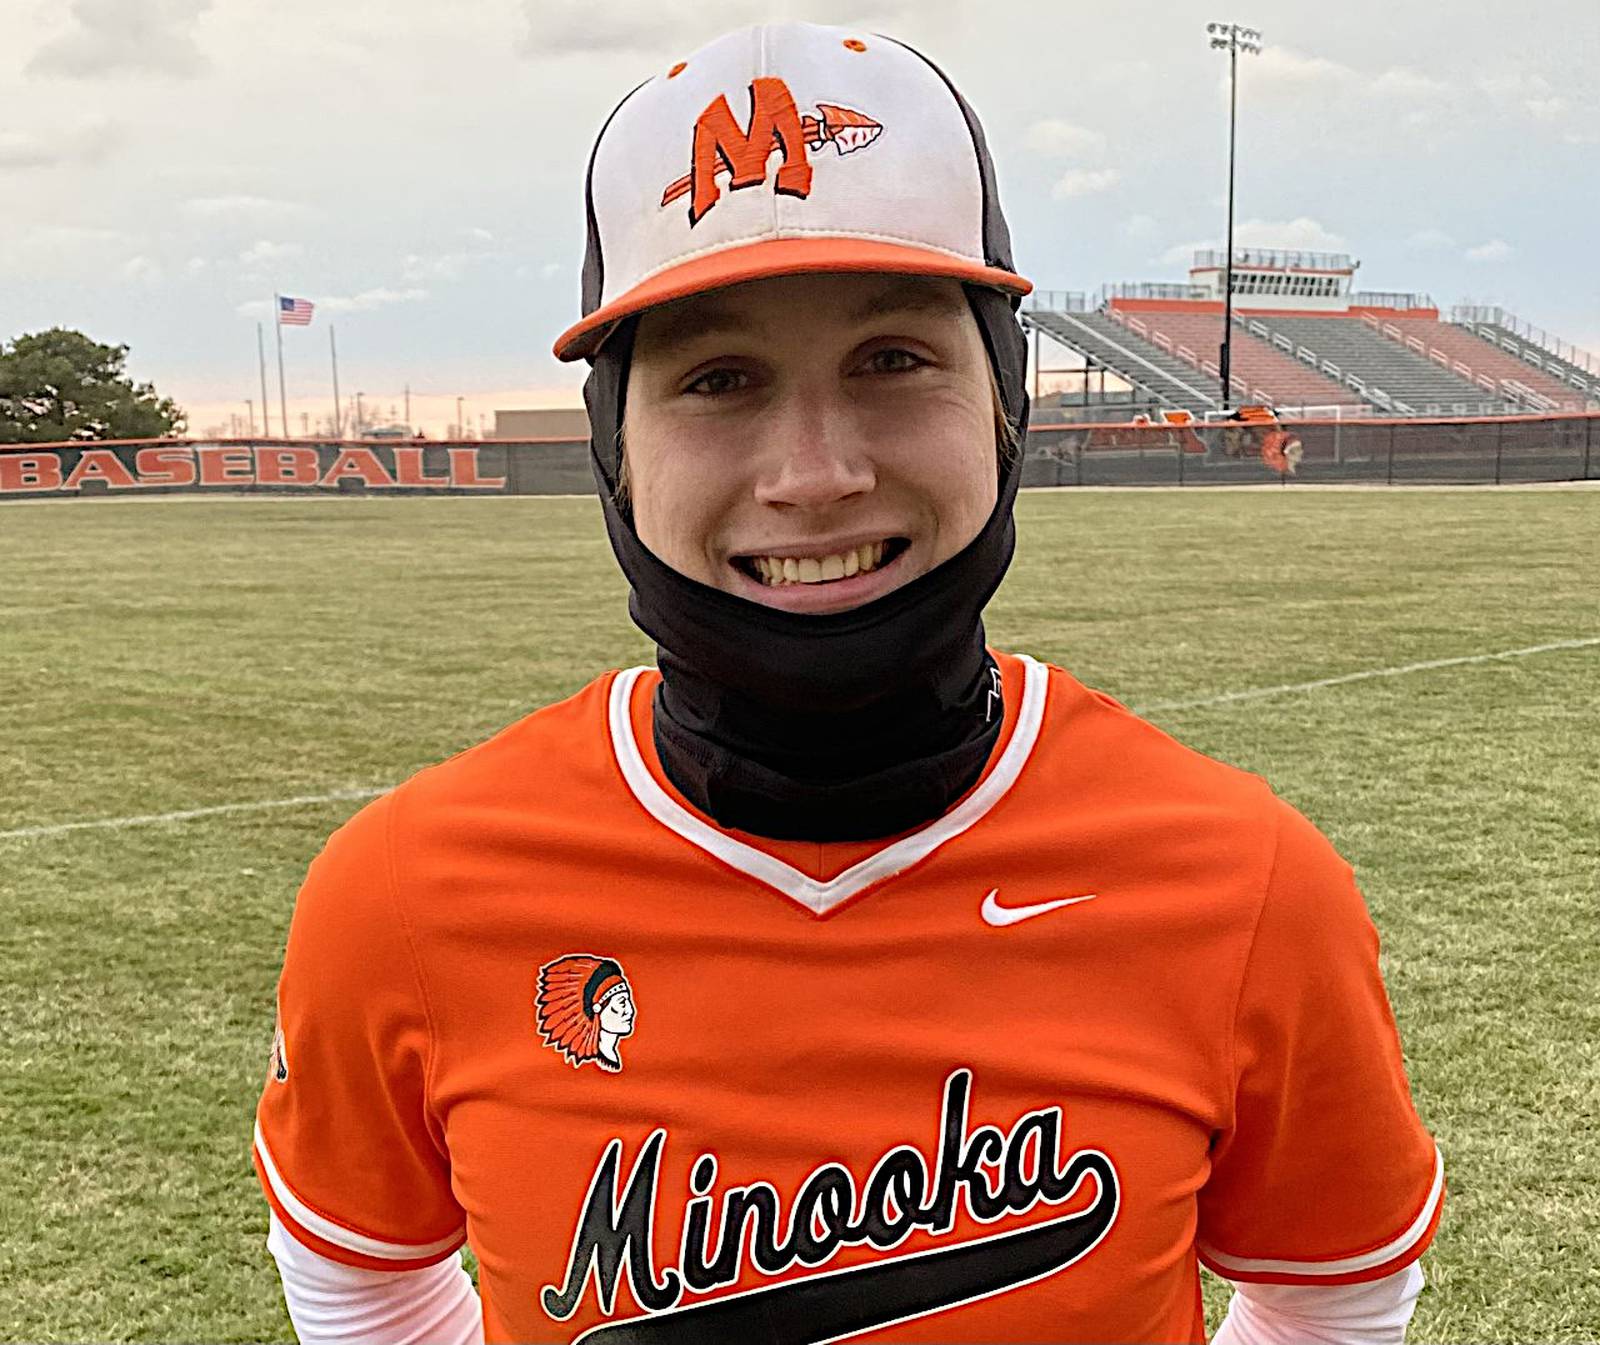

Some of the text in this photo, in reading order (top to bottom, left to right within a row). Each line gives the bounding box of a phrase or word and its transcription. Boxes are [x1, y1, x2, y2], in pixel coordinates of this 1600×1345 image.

[688, 76, 813, 229] M
[0, 447, 506, 492] BASEBALL
[540, 1069, 1098, 1321] Minooka
